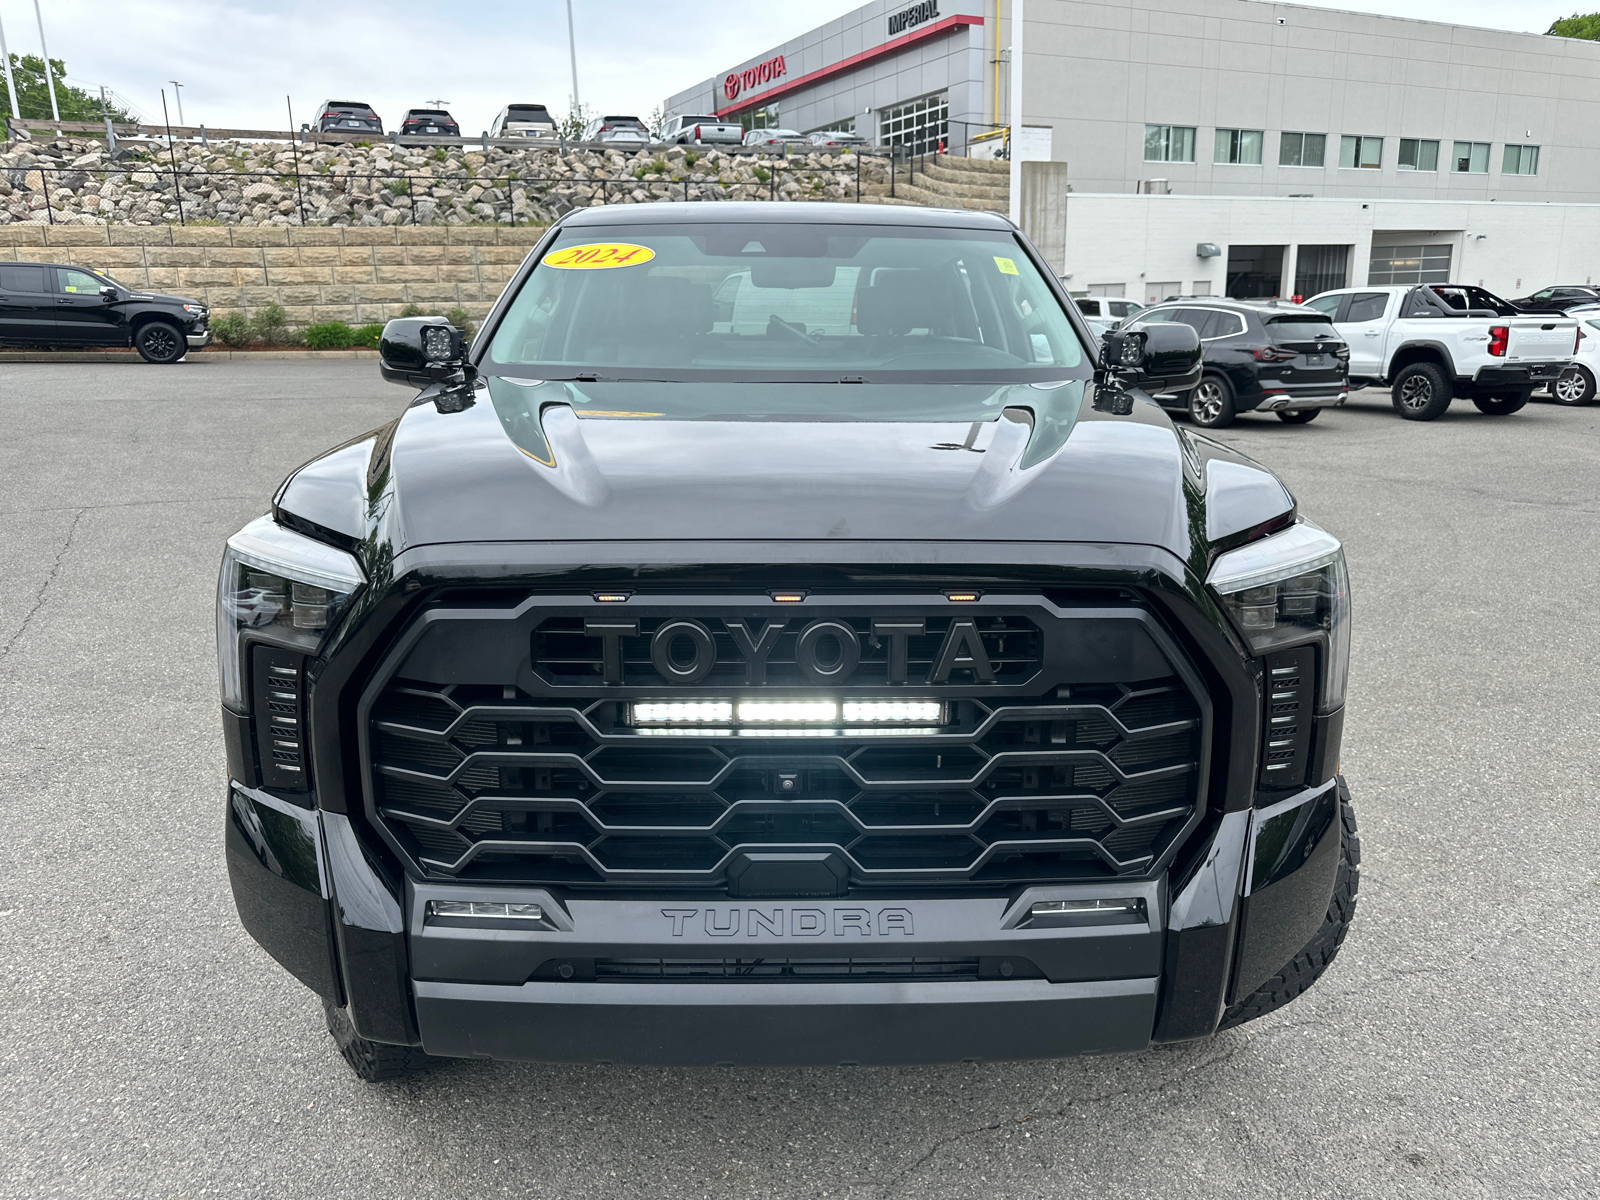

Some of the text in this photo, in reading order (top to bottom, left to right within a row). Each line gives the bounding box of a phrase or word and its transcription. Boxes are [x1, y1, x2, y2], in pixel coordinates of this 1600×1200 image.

[888, 0, 940, 35] IMPERIAL
[739, 55, 786, 91] TOYOTA
[554, 248, 642, 265] 2024
[584, 617, 997, 684] TOYOTA
[660, 908, 914, 937] TUNDRA
